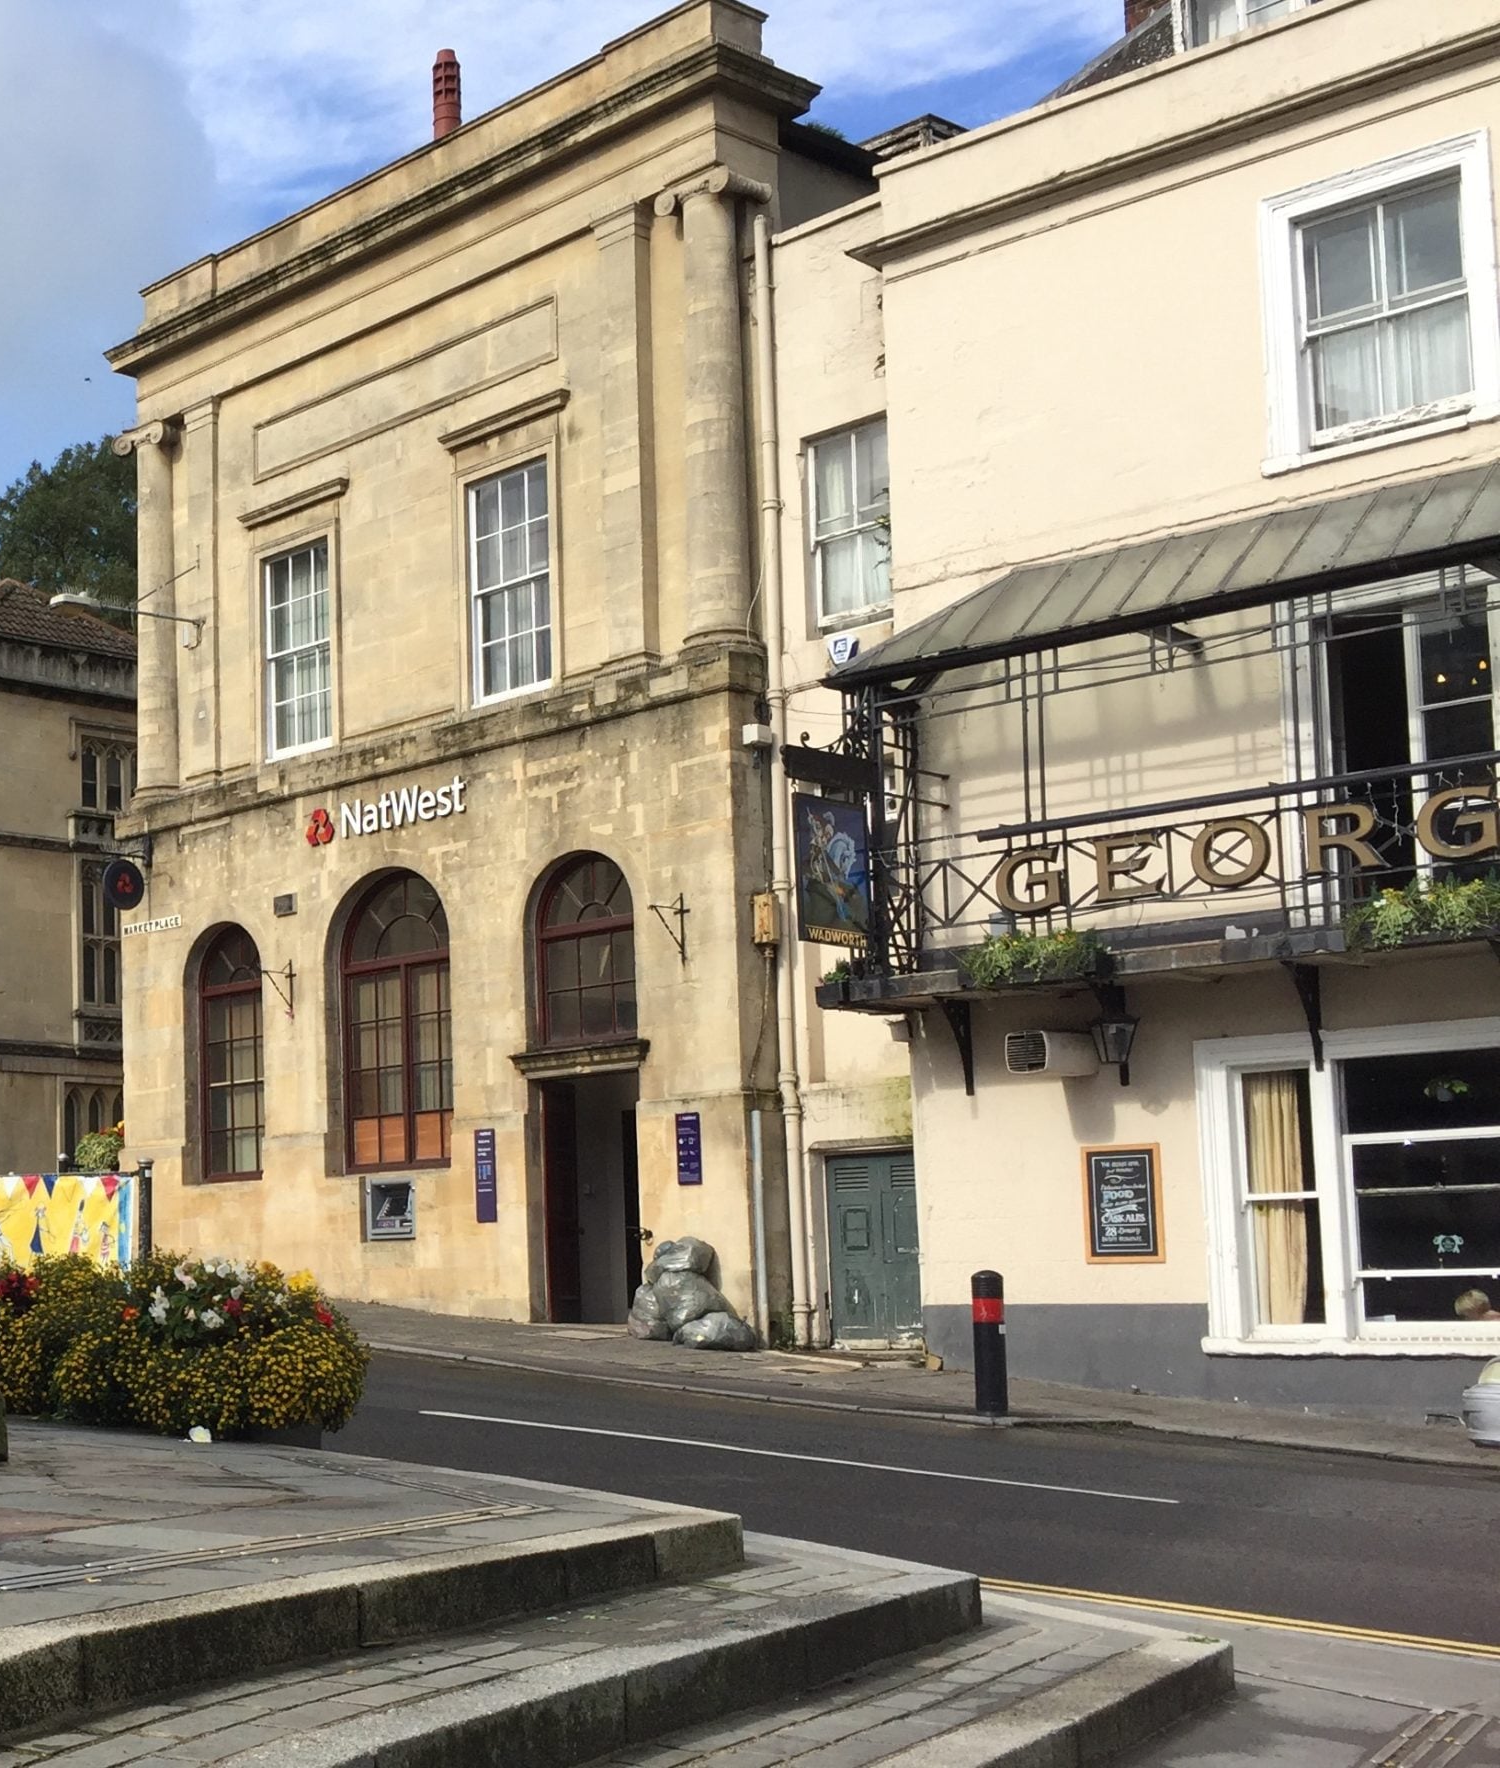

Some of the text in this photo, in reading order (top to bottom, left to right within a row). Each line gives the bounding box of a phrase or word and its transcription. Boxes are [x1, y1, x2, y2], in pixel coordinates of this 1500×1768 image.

[340, 775, 467, 838] NatWest
[123, 916, 180, 935] MARKET PLACE
[808, 927, 868, 947] WADWORTH
[1102, 1189, 1135, 1203] FOOD
